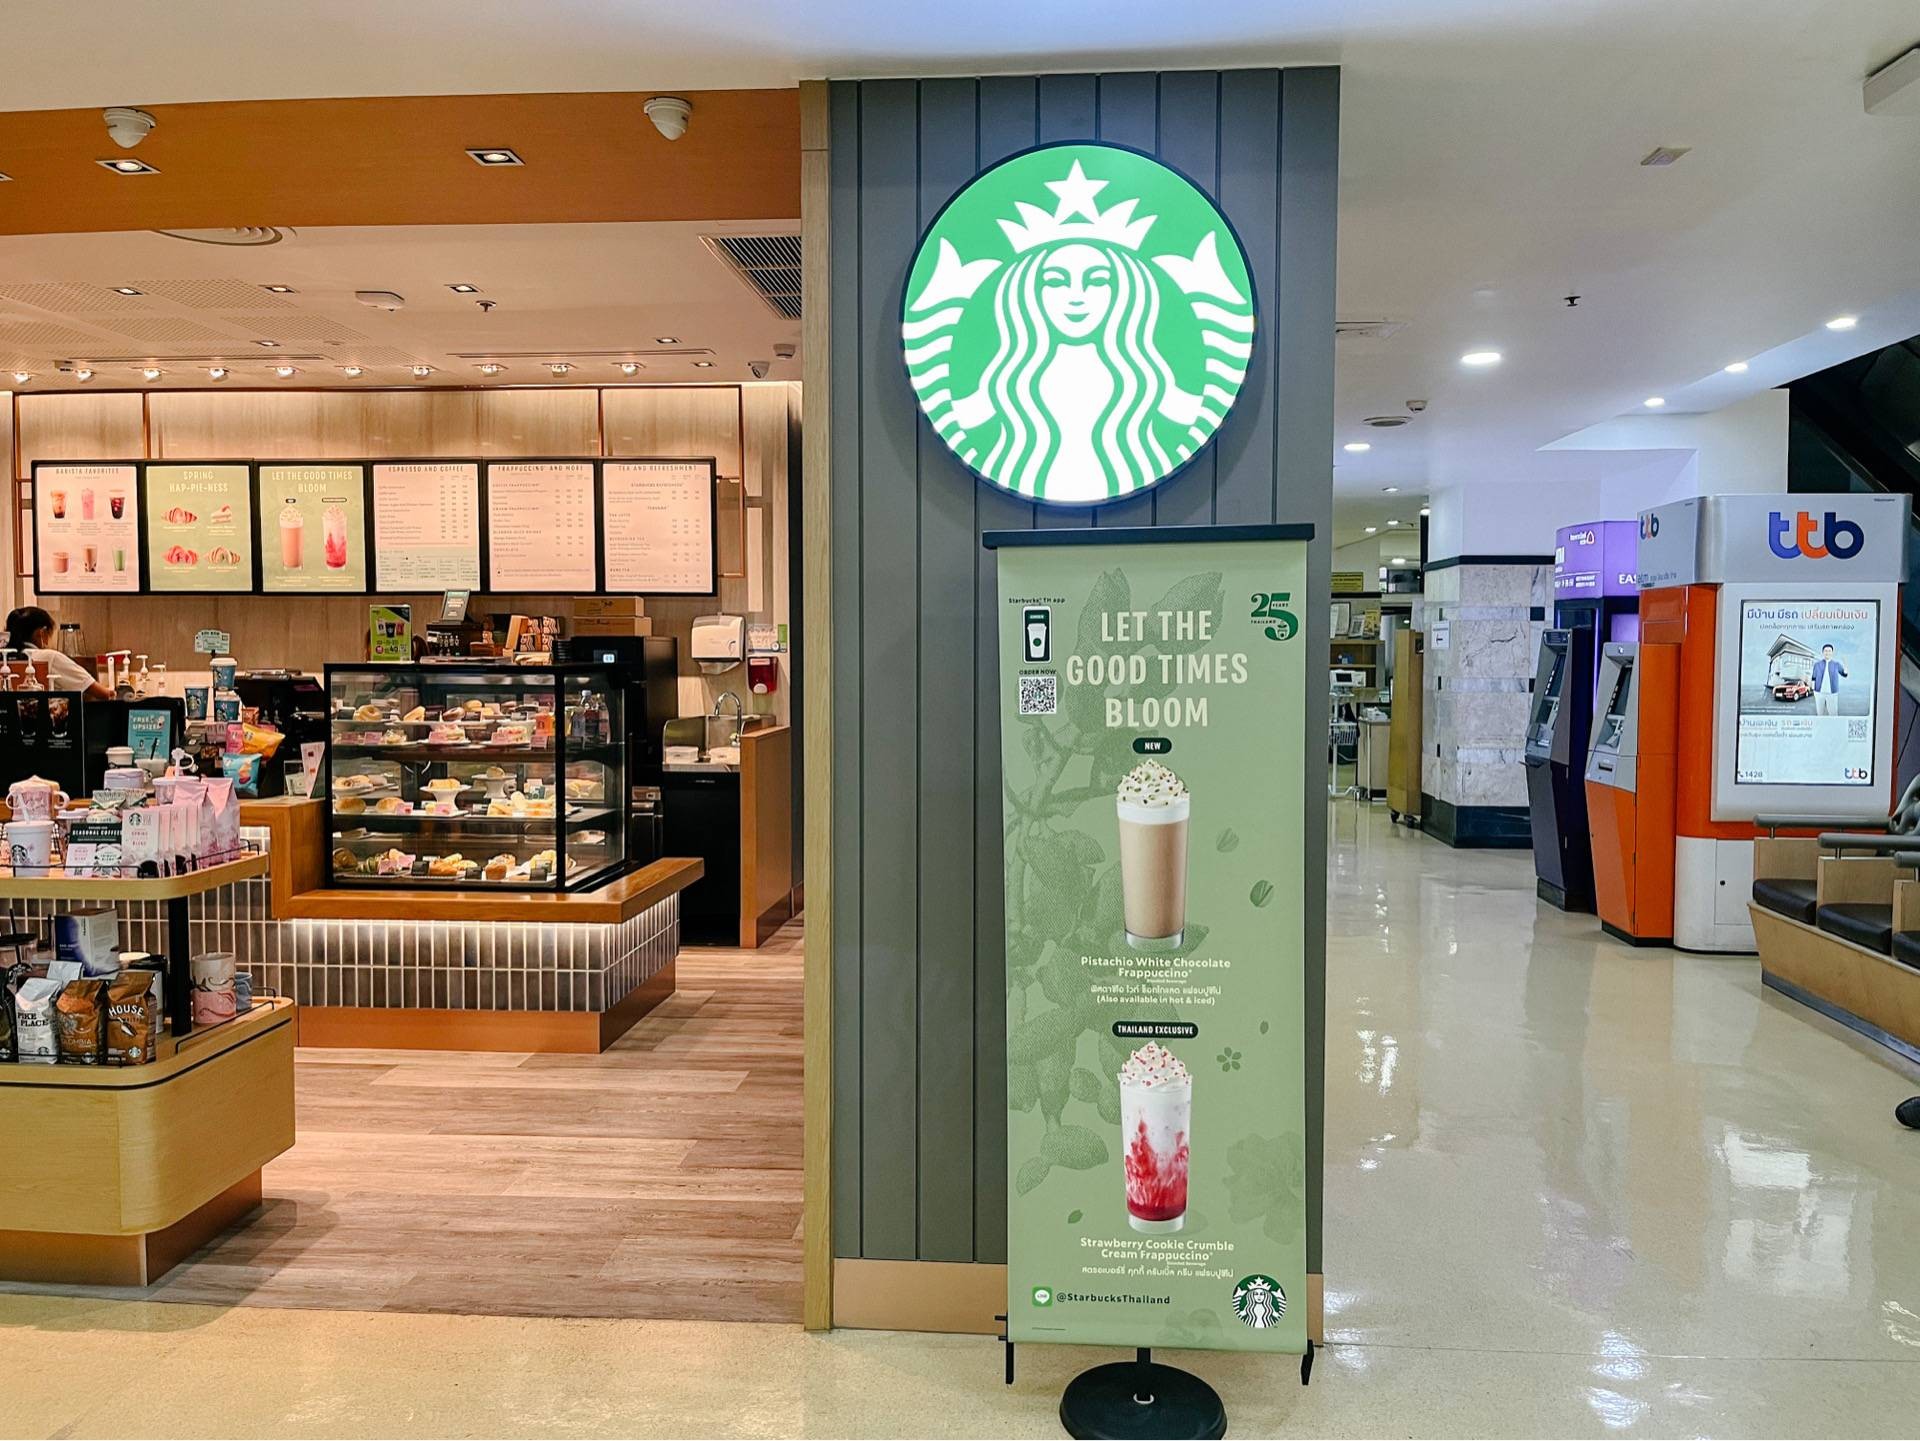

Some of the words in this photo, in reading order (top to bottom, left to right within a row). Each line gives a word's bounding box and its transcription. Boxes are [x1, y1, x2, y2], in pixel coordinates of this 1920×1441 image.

[183, 471, 214, 481] SPRING
[271, 471, 287, 481] LET
[288, 471, 302, 481] THE
[303, 471, 326, 481] GOOD
[327, 471, 353, 480] TIMES
[298, 482, 327, 493] BLOOM
[1640, 513, 1659, 540] ttb
[1769, 511, 1864, 559] ttb
[1251, 592, 1299, 641] 25
[1101, 612, 1147, 642] LET
[1158, 610, 1212, 641] THE
[1066, 654, 1147, 686] GOOD
[1158, 653, 1248, 684] TIMES
[1105, 697, 1208, 727] BLOOM
[1144, 742, 1161, 750] NEW
[1844, 767, 1867, 779] ttb
[1081, 957, 1133, 967] Pistachio
[1135, 957, 1171, 968] White
[1173, 958, 1231, 968] Chocolate
[1097, 995, 1118, 1004] (Also
[1119, 995, 1157, 1004] available
[1169, 996, 1184, 1004] hot
[1194, 996, 1215, 1005] iced)
[18, 1012, 36, 1020] PIKE
[108, 1004, 145, 1017] HOUSE
[21, 1019, 49, 1027] PLACE
[1118, 1025, 1153, 1034] THAILAND
[1155, 1026, 1193, 1035] EXCLUSIVE
[1080, 1237, 1144, 1250] Strawberry
[1146, 1239, 1184, 1250] Cookie
[1187, 1240, 1234, 1251] Crumble
[1101, 1249, 1138, 1259] Cream
[1056, 1292, 1170, 1304] @StarbucksThailand
